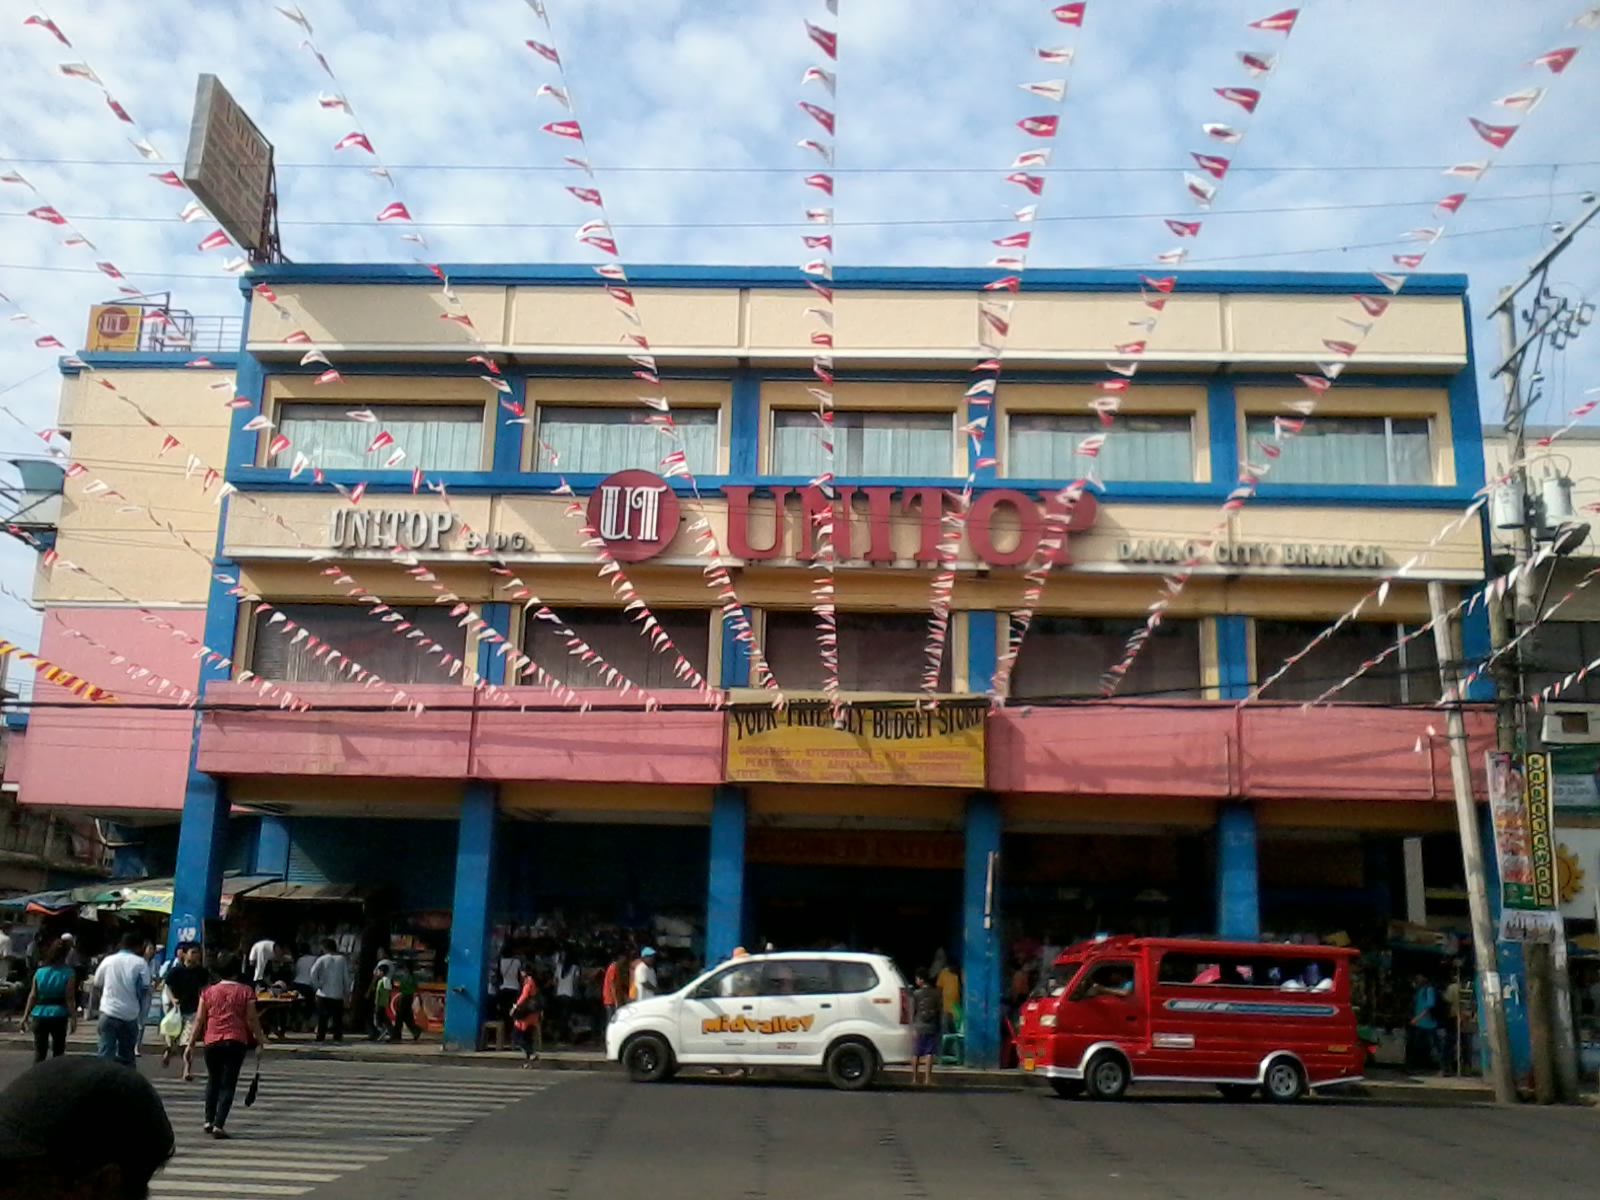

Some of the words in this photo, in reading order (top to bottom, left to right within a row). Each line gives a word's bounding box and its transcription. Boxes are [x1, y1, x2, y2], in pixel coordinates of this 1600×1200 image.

[330, 508, 454, 551] UNITOP
[465, 531, 536, 552] BLDG.
[600, 486, 667, 541] UT
[720, 484, 1098, 566] UNITOP
[1118, 539, 1203, 562] DAVAO
[1214, 540, 1271, 565] CITY
[1281, 543, 1385, 568] BRANCH
[733, 705, 778, 741] YOUR
[787, 699, 867, 736] FRIELY
[873, 707, 934, 739] BUDGET
